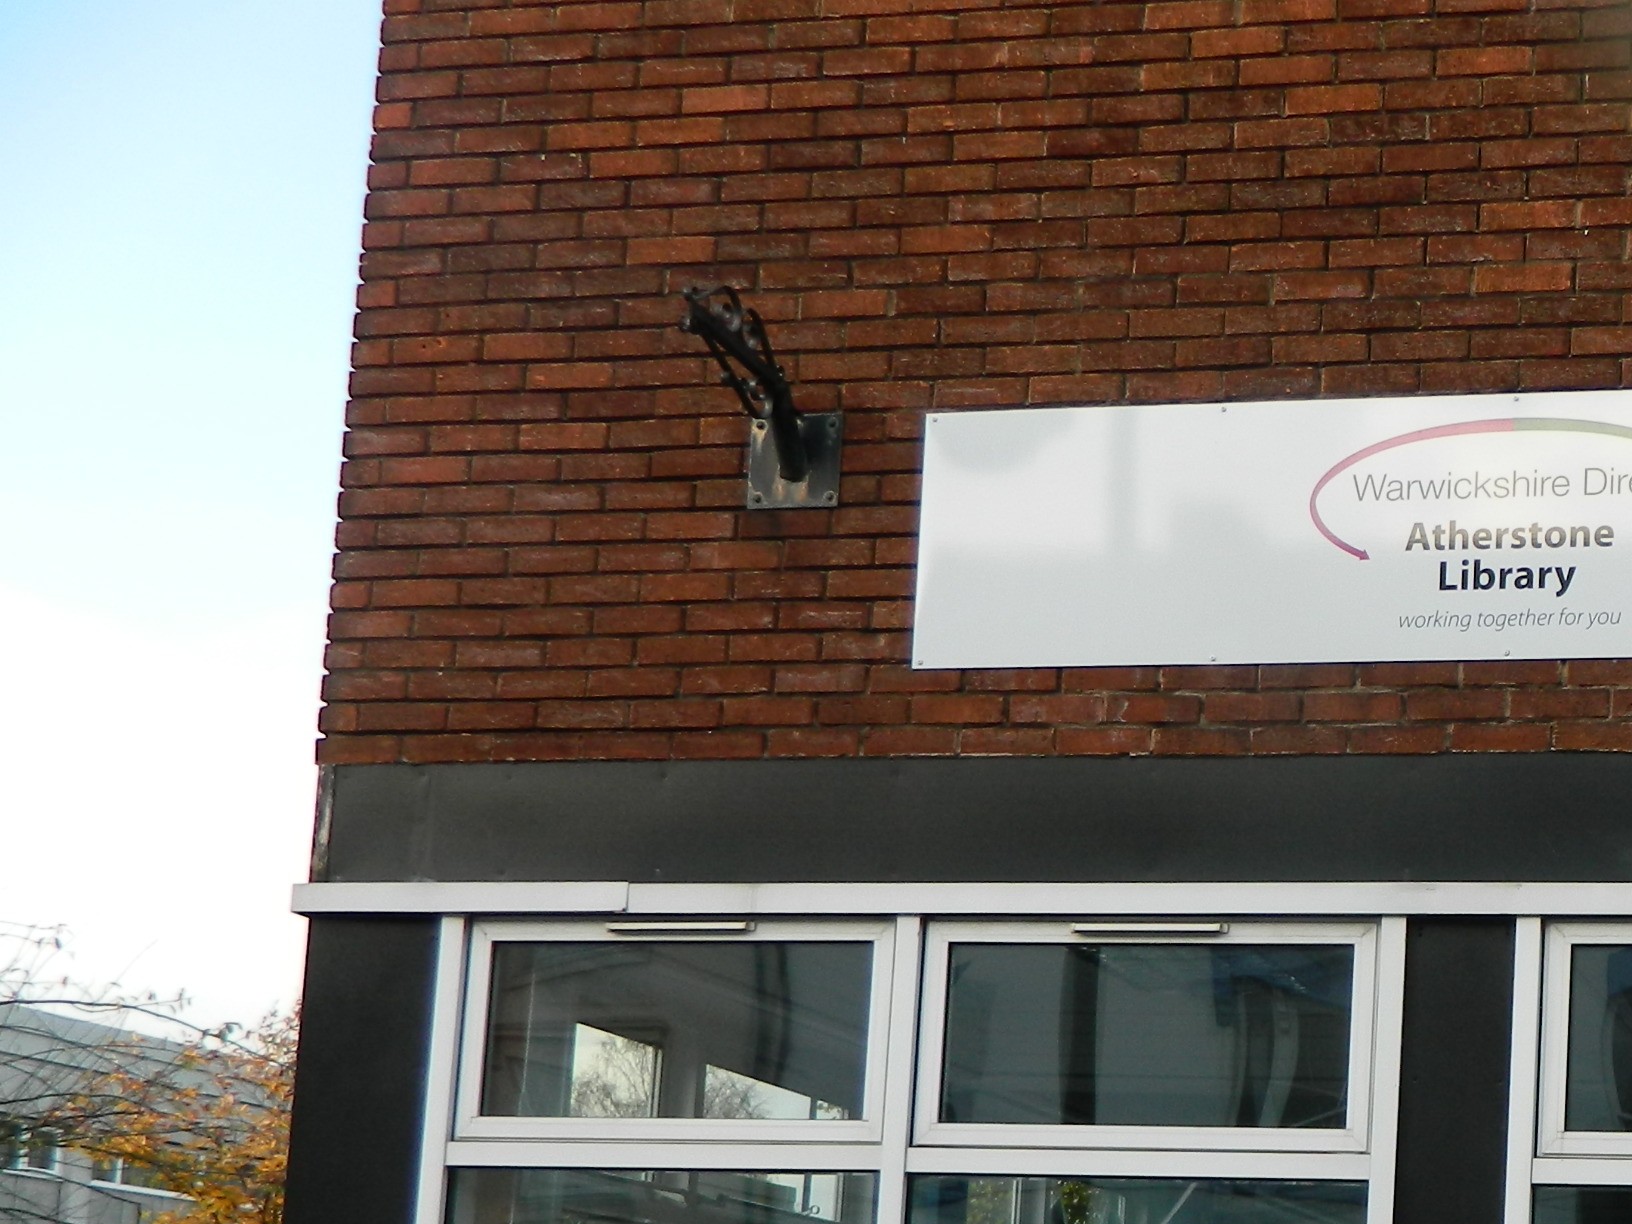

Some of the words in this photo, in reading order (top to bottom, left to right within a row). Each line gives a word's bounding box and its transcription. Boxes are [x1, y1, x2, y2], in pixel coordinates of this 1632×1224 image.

[1352, 469, 1571, 502] Warwickshire
[1405, 519, 1614, 551] Atherstone
[1439, 559, 1576, 597] Library
[1399, 609, 1472, 632] working
[1477, 608, 1555, 632] together
[1558, 607, 1584, 626] for
[1586, 611, 1622, 630] you
